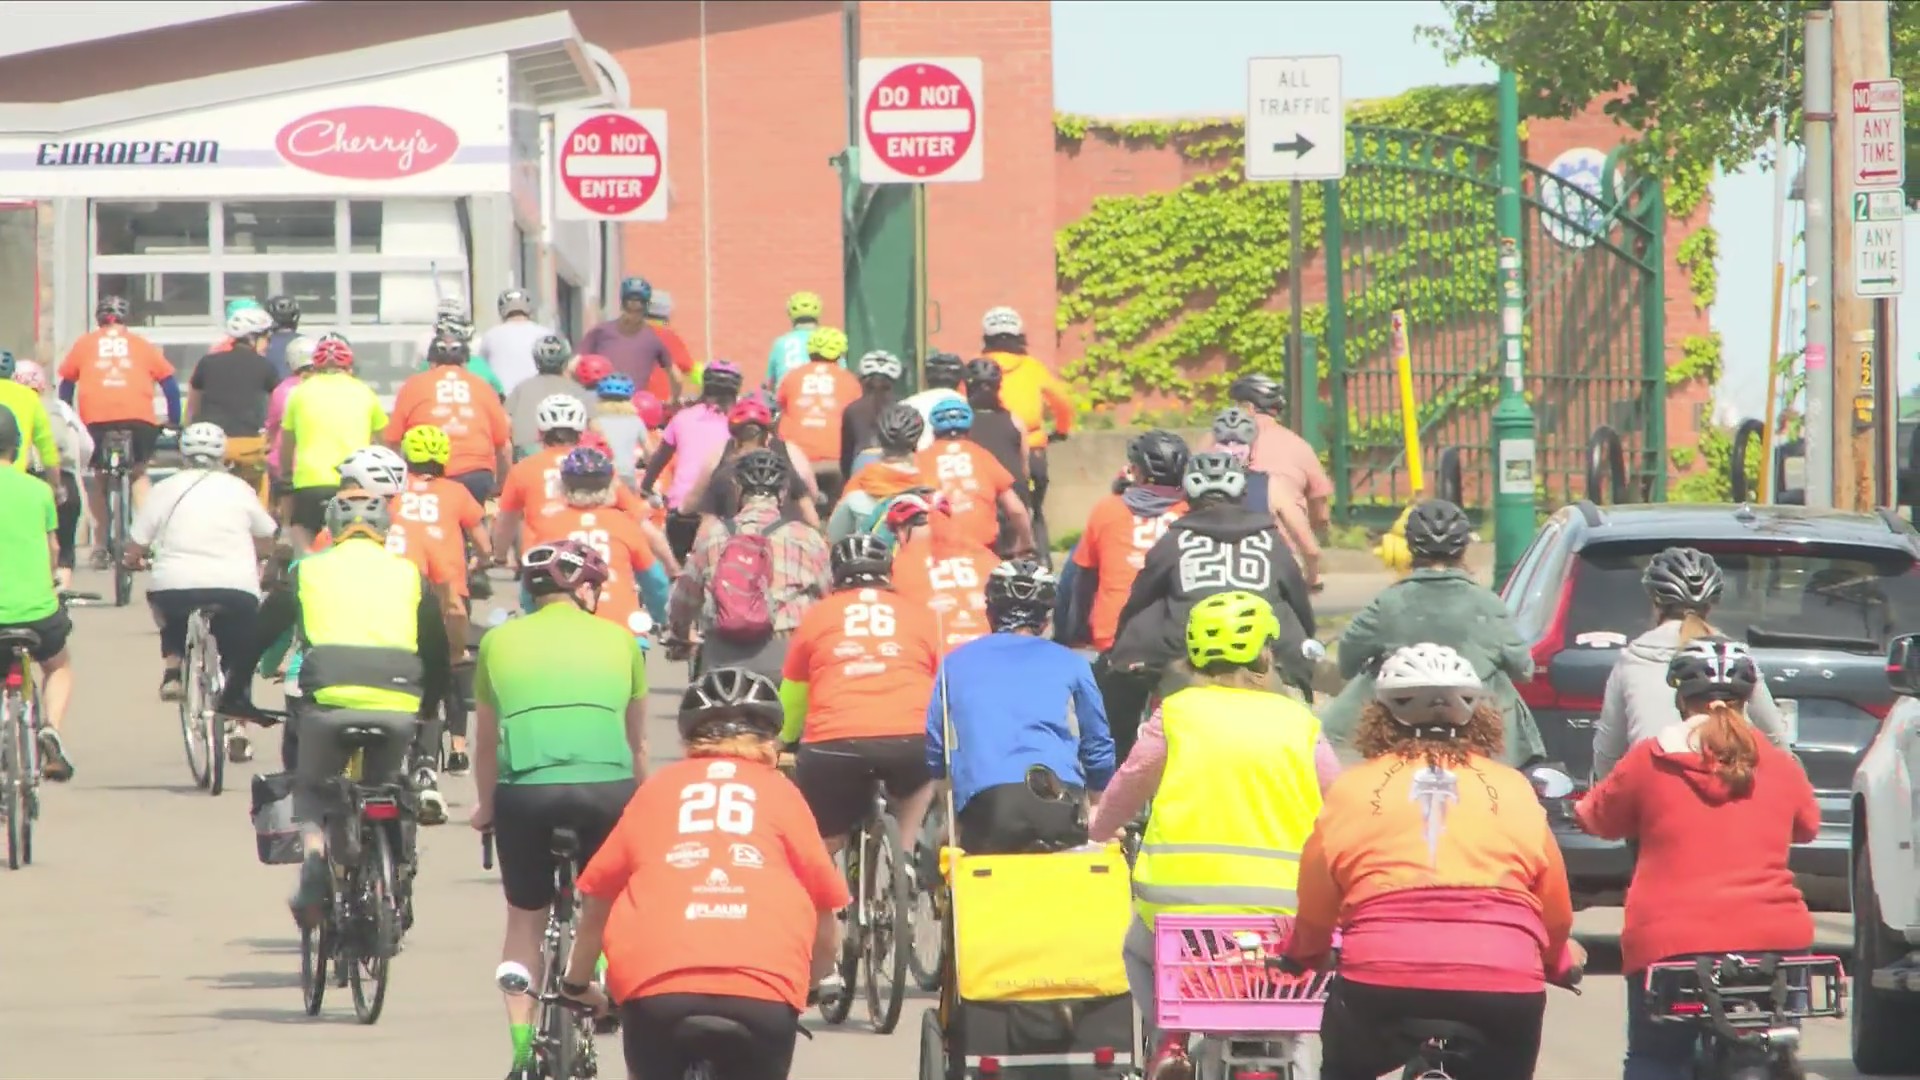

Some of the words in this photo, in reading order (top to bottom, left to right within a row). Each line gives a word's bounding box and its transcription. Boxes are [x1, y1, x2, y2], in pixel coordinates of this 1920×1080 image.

[1278, 70, 1310, 88] ALL
[878, 87, 909, 107] DO
[920, 85, 961, 106] NOT
[1259, 97, 1331, 114] TRAFFIC
[1855, 88, 1869, 109] NO
[1863, 118, 1891, 138] ANY
[36, 141, 219, 166] EUROPEAN
[287, 120, 438, 170] Cherry's
[573, 134, 600, 153] DO
[611, 133, 648, 153] NOT
[887, 137, 956, 158] ENTER
[1861, 141, 1895, 163] TIME
[579, 180, 643, 199] ENTER
[1857, 194, 1868, 220] 2
[1865, 228, 1892, 246] ANY
[1862, 250, 1897, 270] TIME
[98, 337, 128, 358] 26
[435, 380, 471, 404] 26
[801, 374, 835, 396] 26
[936, 452, 973, 479] 26
[400, 491, 440, 523] 26
[1177, 530, 1273, 592] 26
[844, 603, 896, 637] 26
[678, 782, 757, 836] 26
